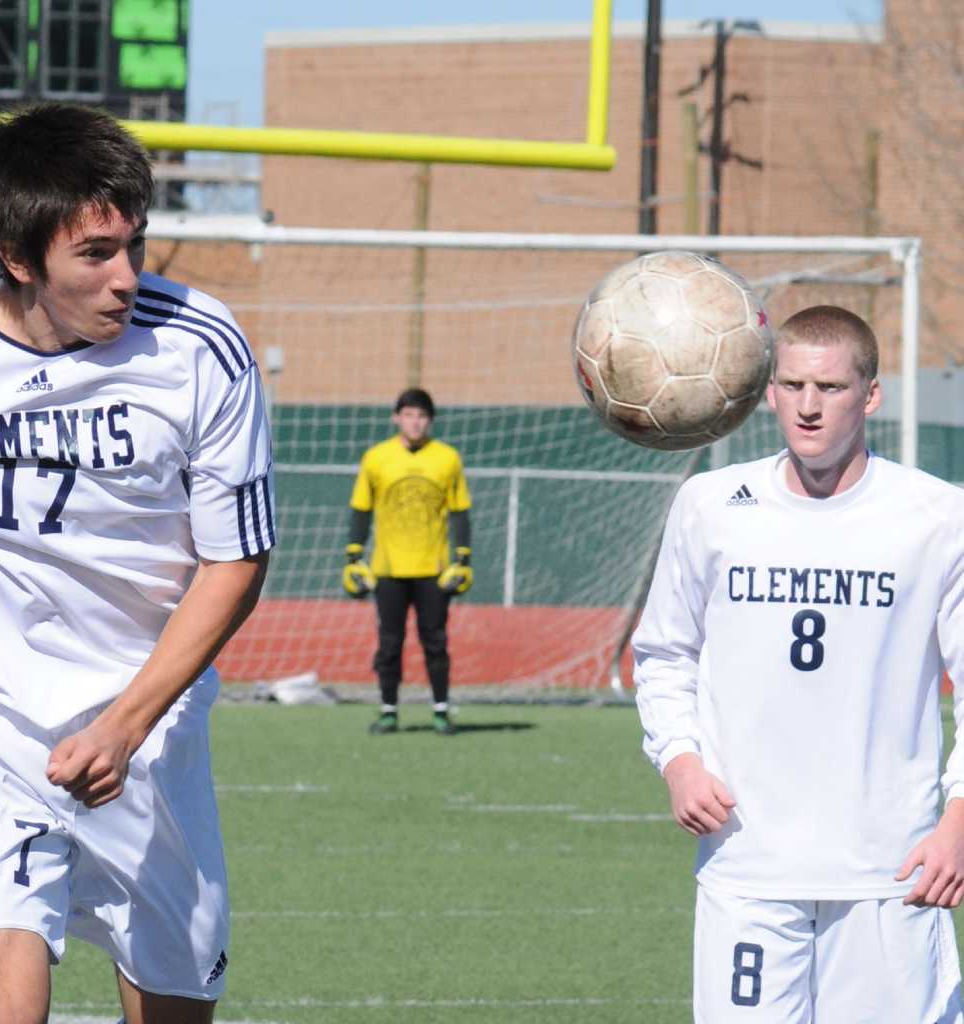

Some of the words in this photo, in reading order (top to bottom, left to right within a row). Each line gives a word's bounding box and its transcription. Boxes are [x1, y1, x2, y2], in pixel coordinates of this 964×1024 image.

[728, 566, 896, 608] CLEMENTS
[789, 609, 827, 672] 8
[731, 941, 764, 1007] 8
